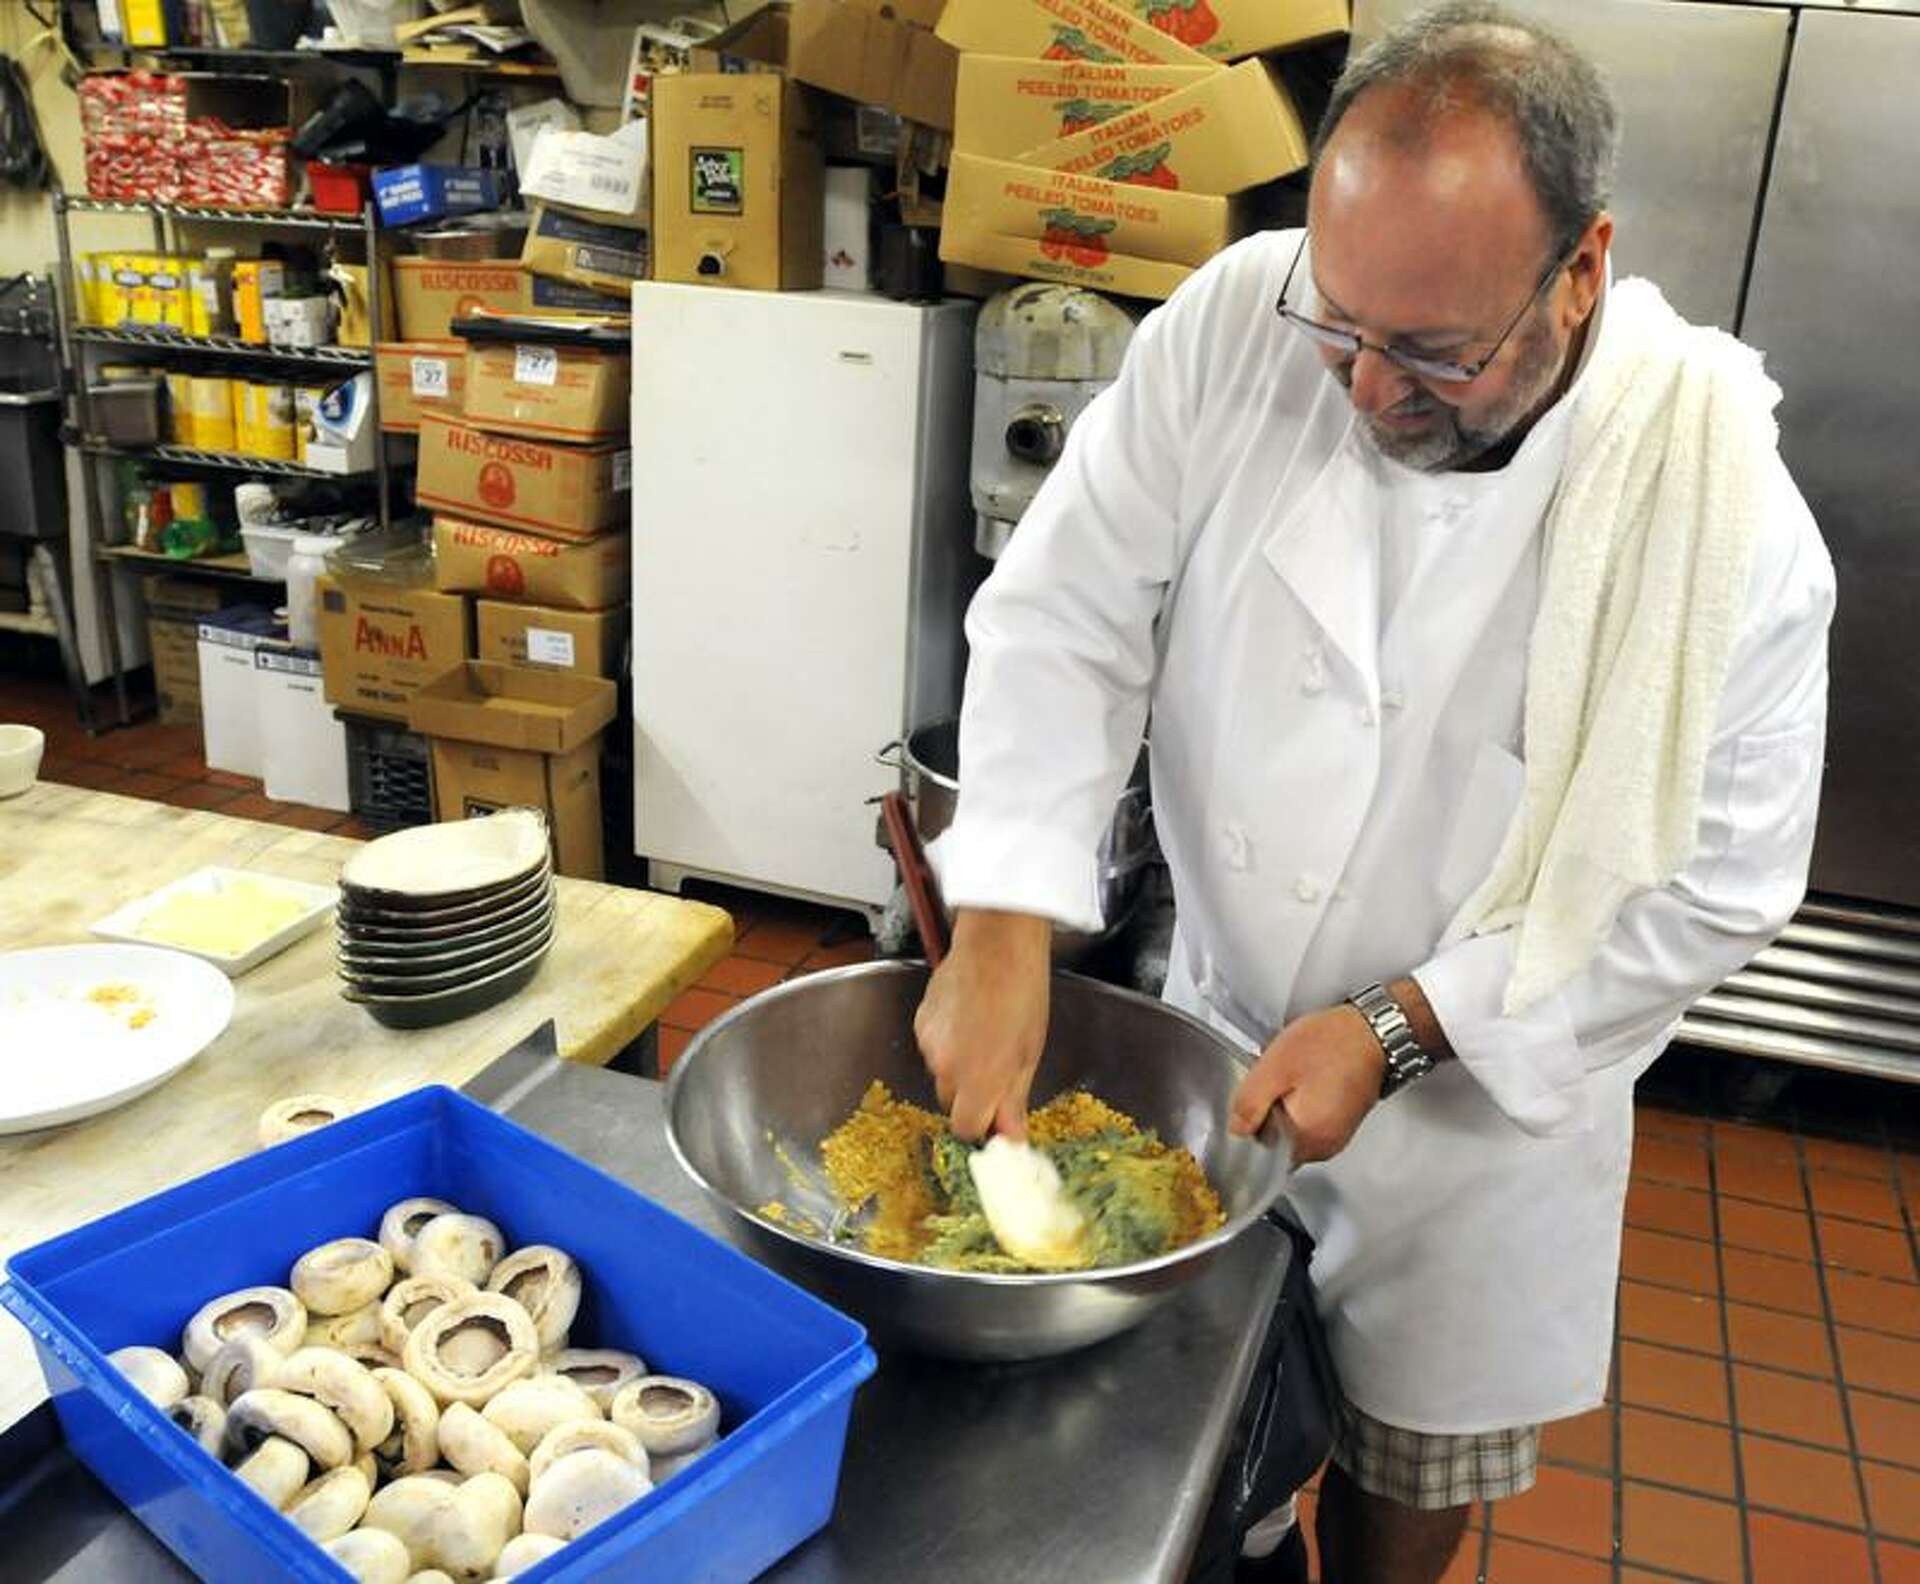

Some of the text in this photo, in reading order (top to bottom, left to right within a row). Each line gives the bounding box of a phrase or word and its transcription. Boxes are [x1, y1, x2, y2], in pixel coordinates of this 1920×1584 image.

[1017, 80, 1078, 98] PEELED
[1091, 110, 1151, 142] ITALIAN
[1118, 108, 1204, 149] TOMATOES
[1051, 174, 1114, 196] ITALIAN
[1005, 183, 1158, 221] PEELED TOMATOES
[422, 270, 519, 290] RISCOSSA
[448, 430, 552, 469] RISCOSSA
